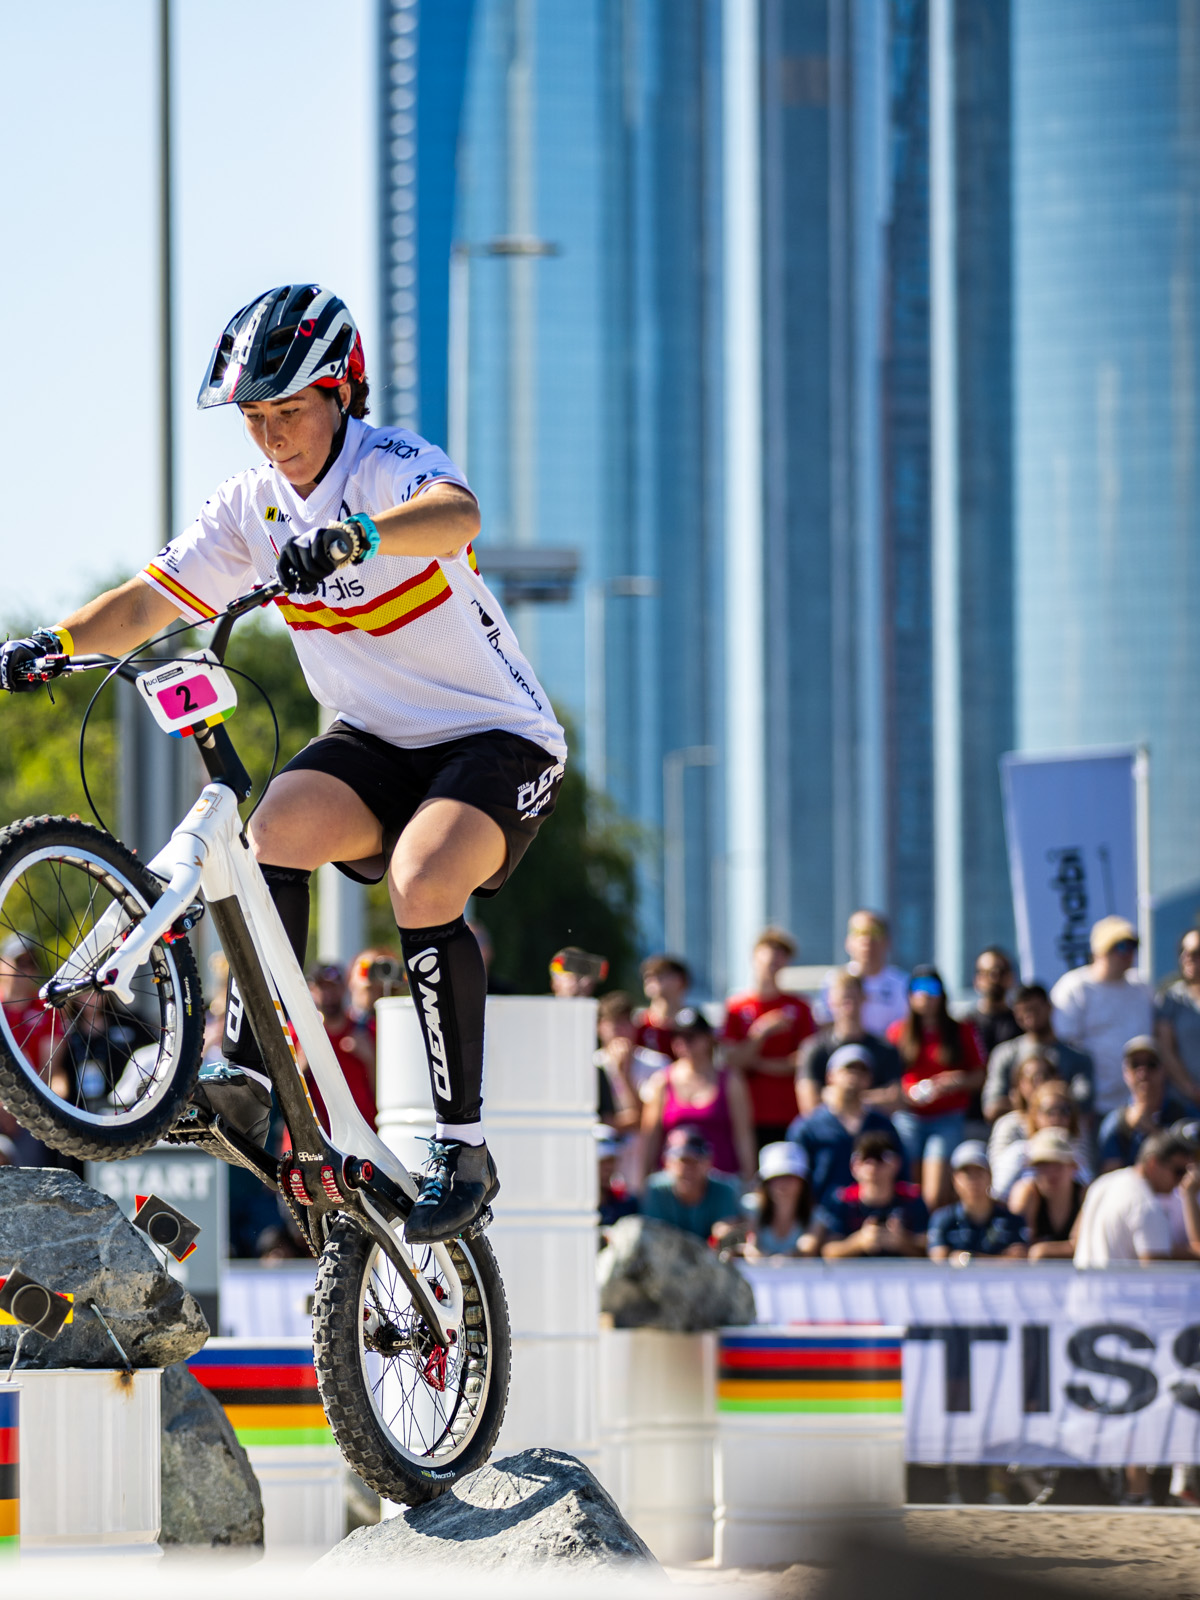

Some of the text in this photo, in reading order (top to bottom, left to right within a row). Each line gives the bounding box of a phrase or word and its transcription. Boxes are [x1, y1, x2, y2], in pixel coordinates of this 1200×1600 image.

[176, 685, 199, 713] 2
[417, 981, 452, 1102] CLEAN
[100, 1164, 212, 1199] START
